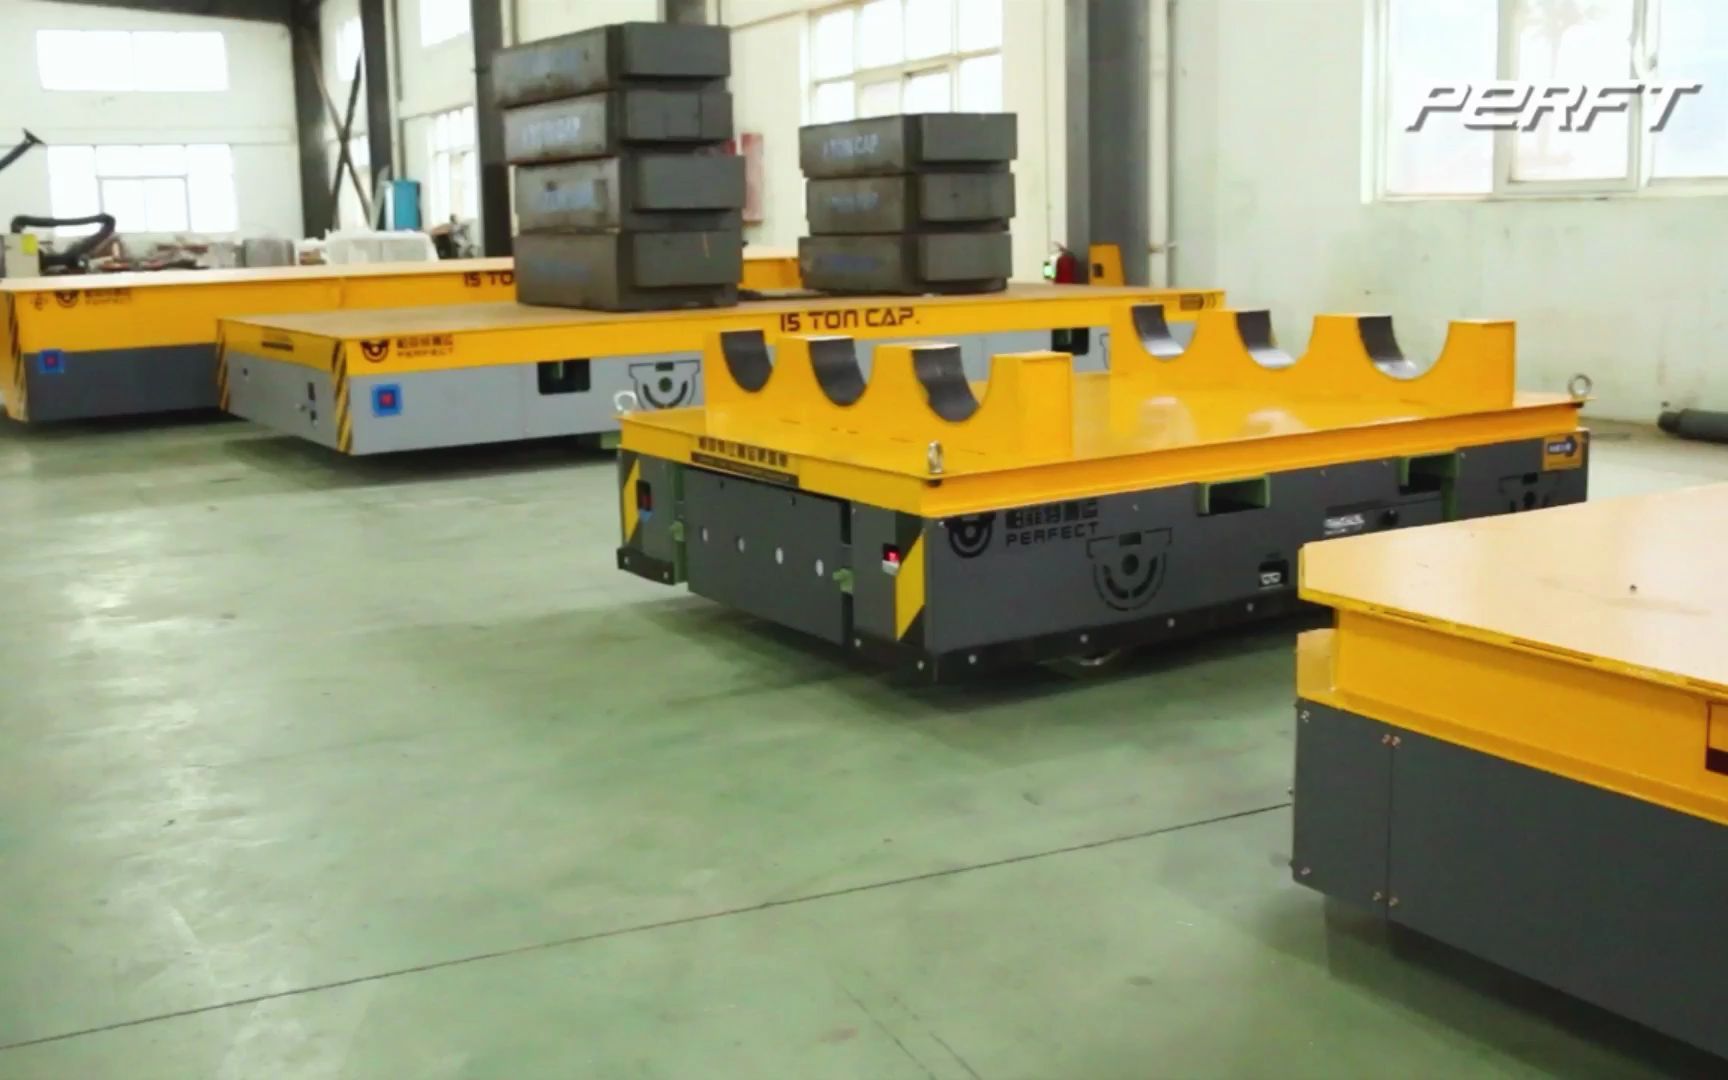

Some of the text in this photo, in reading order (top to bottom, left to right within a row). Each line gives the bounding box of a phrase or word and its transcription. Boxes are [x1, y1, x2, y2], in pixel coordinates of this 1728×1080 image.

[487, 270, 514, 286] TO
[780, 306, 920, 333] 15 TON CAP.
[1006, 521, 1099, 548] PERFECT
